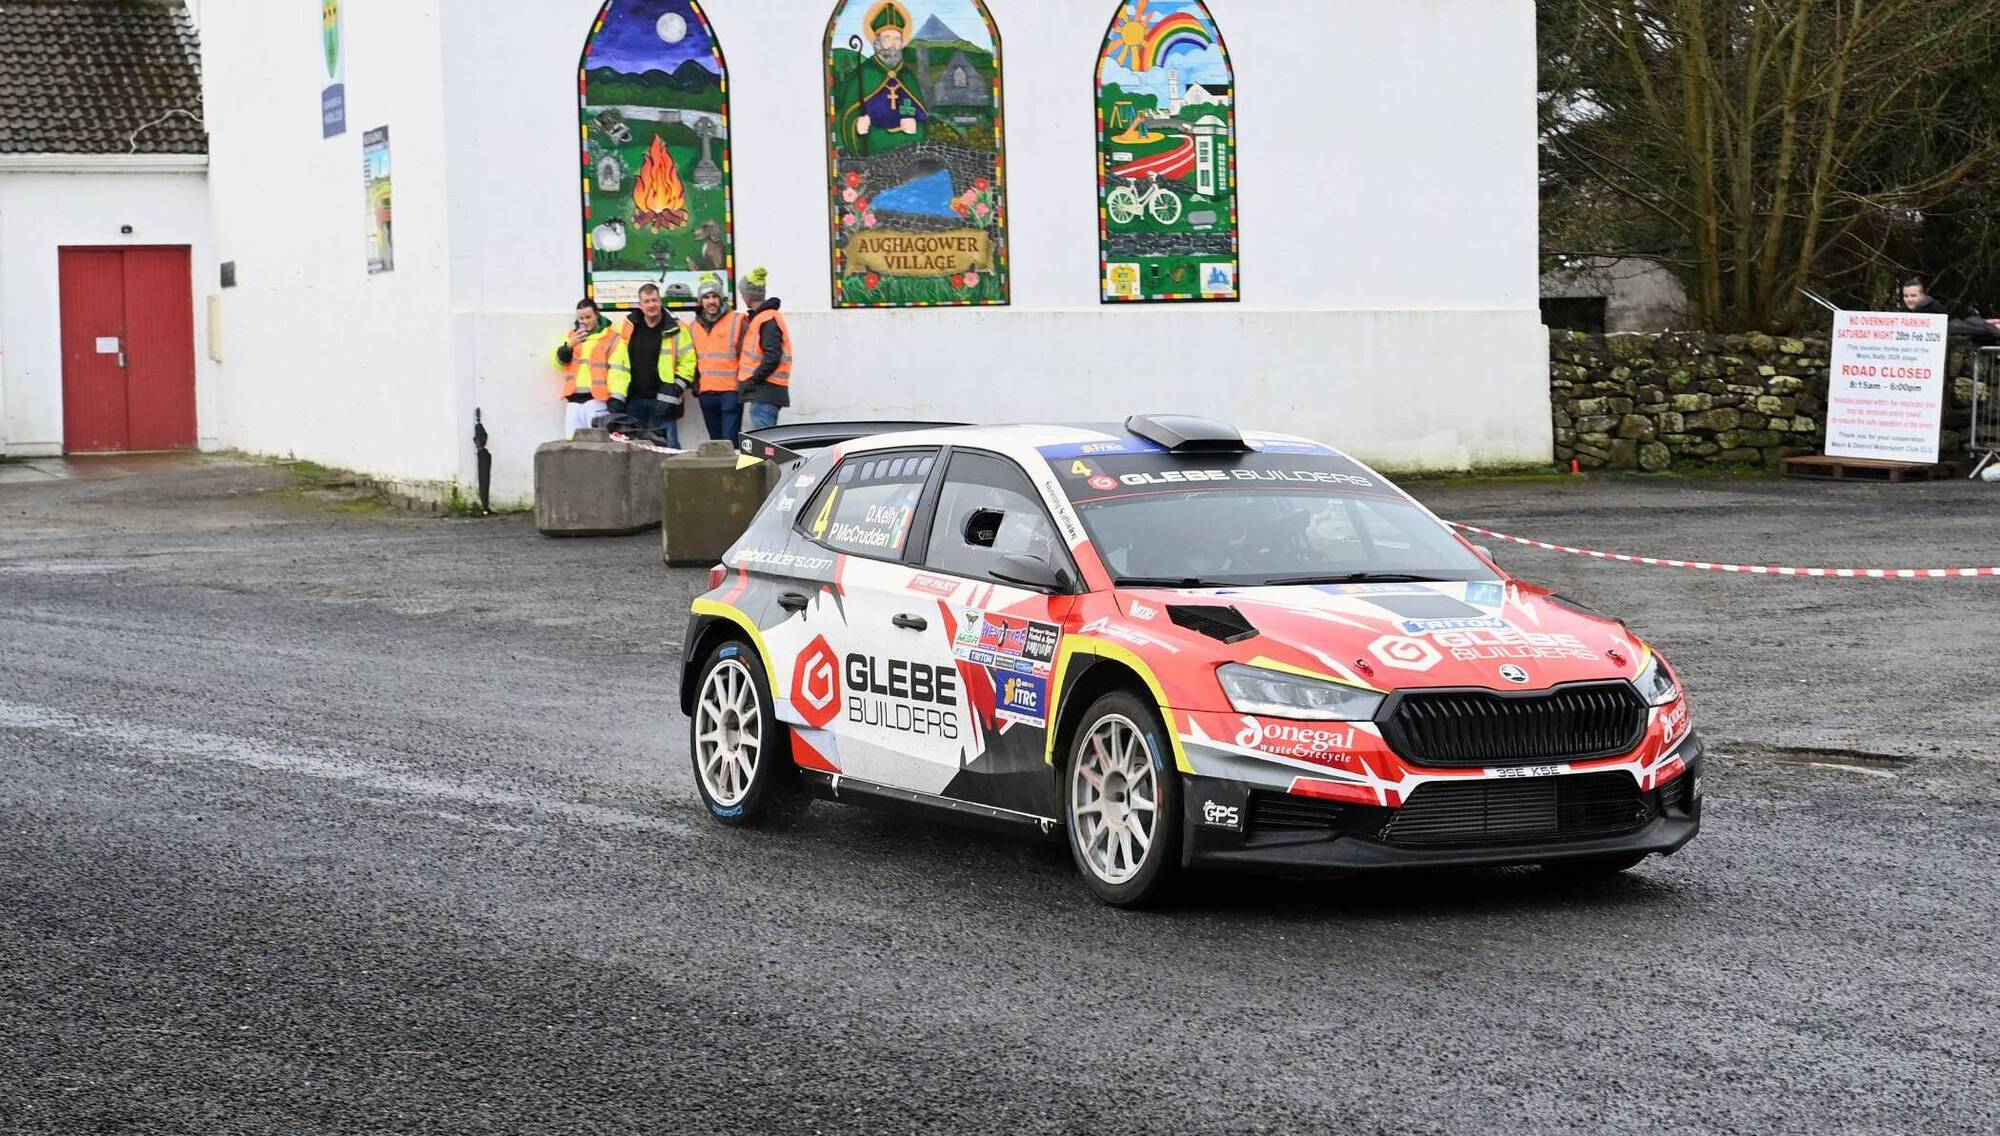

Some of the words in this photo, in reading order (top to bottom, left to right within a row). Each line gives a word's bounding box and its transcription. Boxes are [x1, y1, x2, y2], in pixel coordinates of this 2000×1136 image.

[859, 237, 979, 253] AUGHAGOWER
[884, 255, 956, 270] VILLAGE
[1861, 316, 1899, 327] OVERNIGHT
[1901, 318, 1931, 328] PARKING
[1838, 329, 1871, 339] SATURDAY
[1873, 330, 1895, 340] NIGHT
[1842, 364, 1877, 377] ROAD
[1881, 366, 1932, 379] CLOSED
[1849, 381, 1880, 390] 8:15am
[1071, 460, 1092, 477] 4
[1119, 470, 1230, 486] GLEBE
[1231, 469, 1373, 487] BUILDERS
[813, 486, 838, 539] 4
[865, 504, 897, 529] D.Kelly
[1417, 617, 1507, 630] TRITON
[1432, 630, 1587, 648] GLEBE
[1450, 647, 1600, 662] BUILDERS
[846, 653, 957, 706] GLEBE
[1014, 688, 1037, 707] ITRC
[849, 696, 958, 739] BUILDERS
